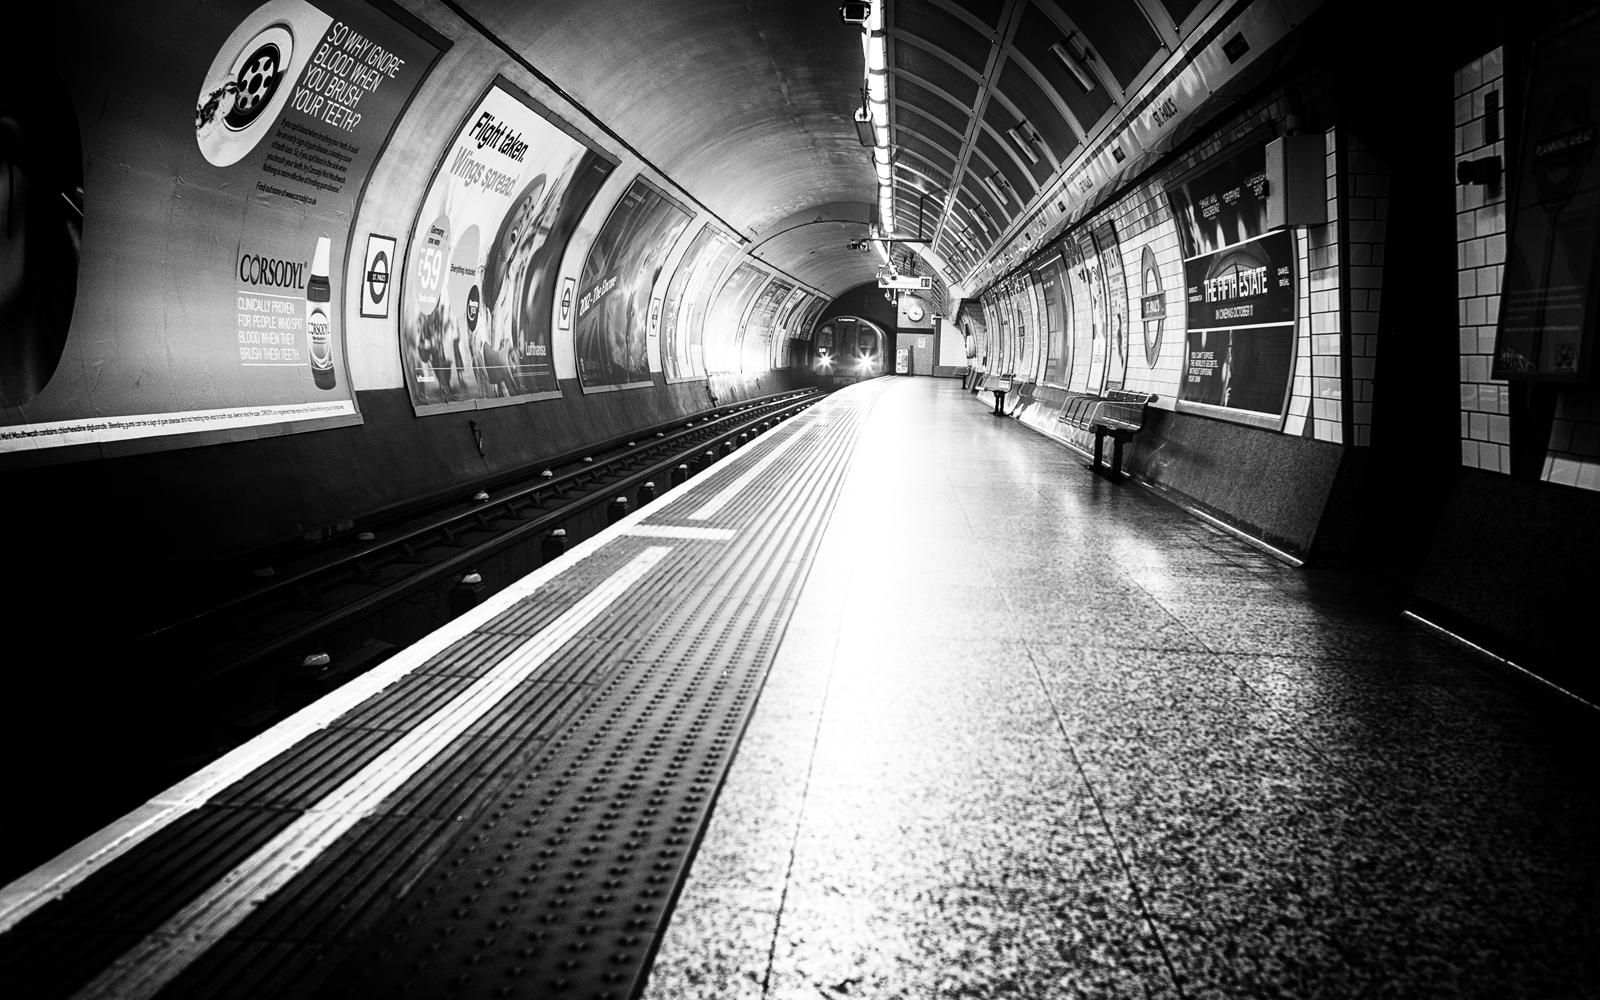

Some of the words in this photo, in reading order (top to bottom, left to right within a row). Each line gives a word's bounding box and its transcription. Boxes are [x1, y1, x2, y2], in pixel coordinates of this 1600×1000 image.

[314, 43, 354, 77] BLOOD
[350, 62, 384, 93] WHEN
[327, 22, 348, 46] SO
[343, 30, 373, 58] WHY
[365, 44, 405, 78] IGNORE
[303, 64, 330, 91] YOU
[324, 76, 364, 108] BRUSH
[291, 86, 324, 117] YOUR
[321, 100, 361, 132] TEETH?
[469, 111, 507, 149] Flight
[498, 129, 529, 163] taken.
[450, 146, 485, 187] Wings
[481, 168, 520, 198] spread.
[240, 254, 304, 289] CORSODYL
[1204, 278, 1217, 302] THE
[1217, 273, 1237, 300] FIFTH
[1239, 266, 1267, 297] ESTATE
[238, 297, 271, 312] CLINICALLY
[272, 300, 295, 314] PROVEN
[238, 314, 251, 327] FOR
[253, 315, 277, 328] PEOPLE
[278, 316, 291, 329] WHO
[291, 318, 303, 330] SPIT
[239, 330, 260, 344] BLOOD
[261, 331, 279, 344] WHEN
[280, 332, 294, 345] THEY
[240, 347, 262, 360] BRUSH
[263, 348, 280, 360] THEIR
[280, 348, 300, 360] TEETH
[526, 341, 546, 356] Lufthansa
